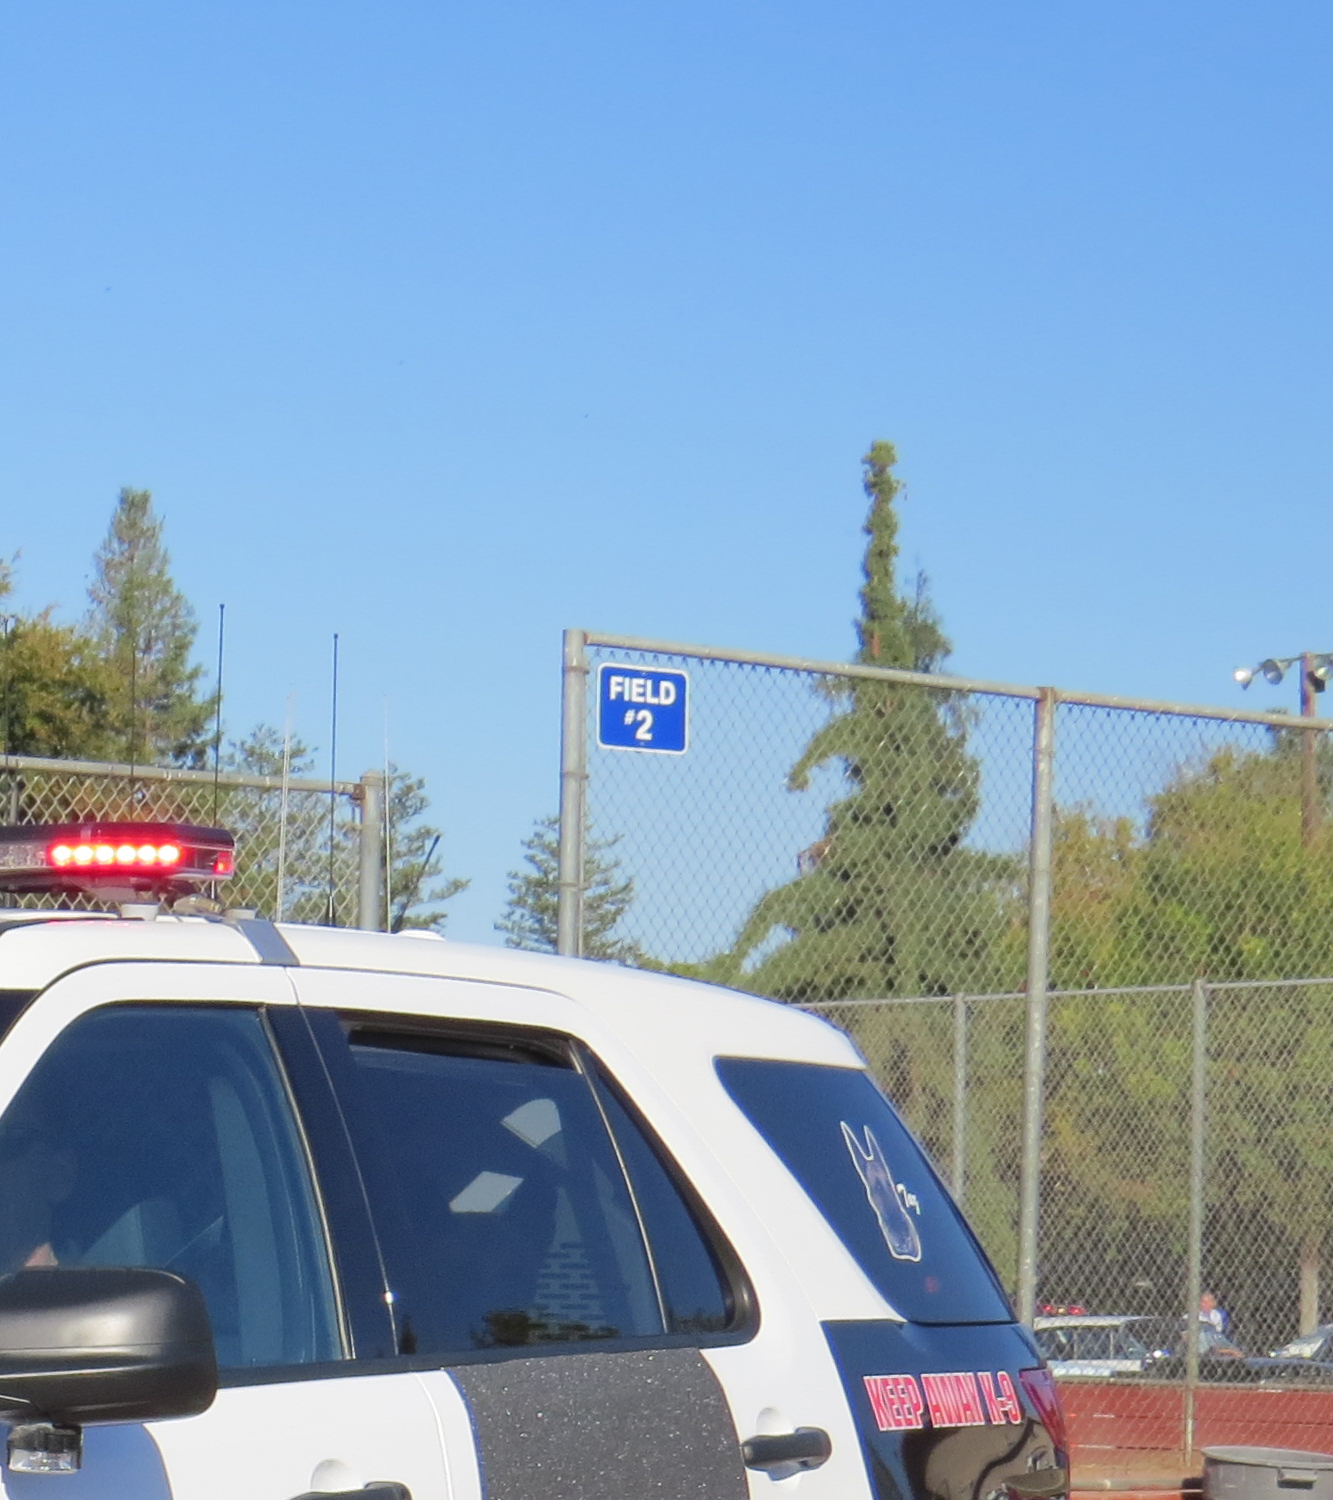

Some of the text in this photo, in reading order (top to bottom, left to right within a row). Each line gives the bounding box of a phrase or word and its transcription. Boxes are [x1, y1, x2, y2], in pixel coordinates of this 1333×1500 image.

[609, 675, 678, 706] FIELD
[623, 709, 654, 741] #2
[862, 1370, 1022, 1432] KEEP AWAY K-9
